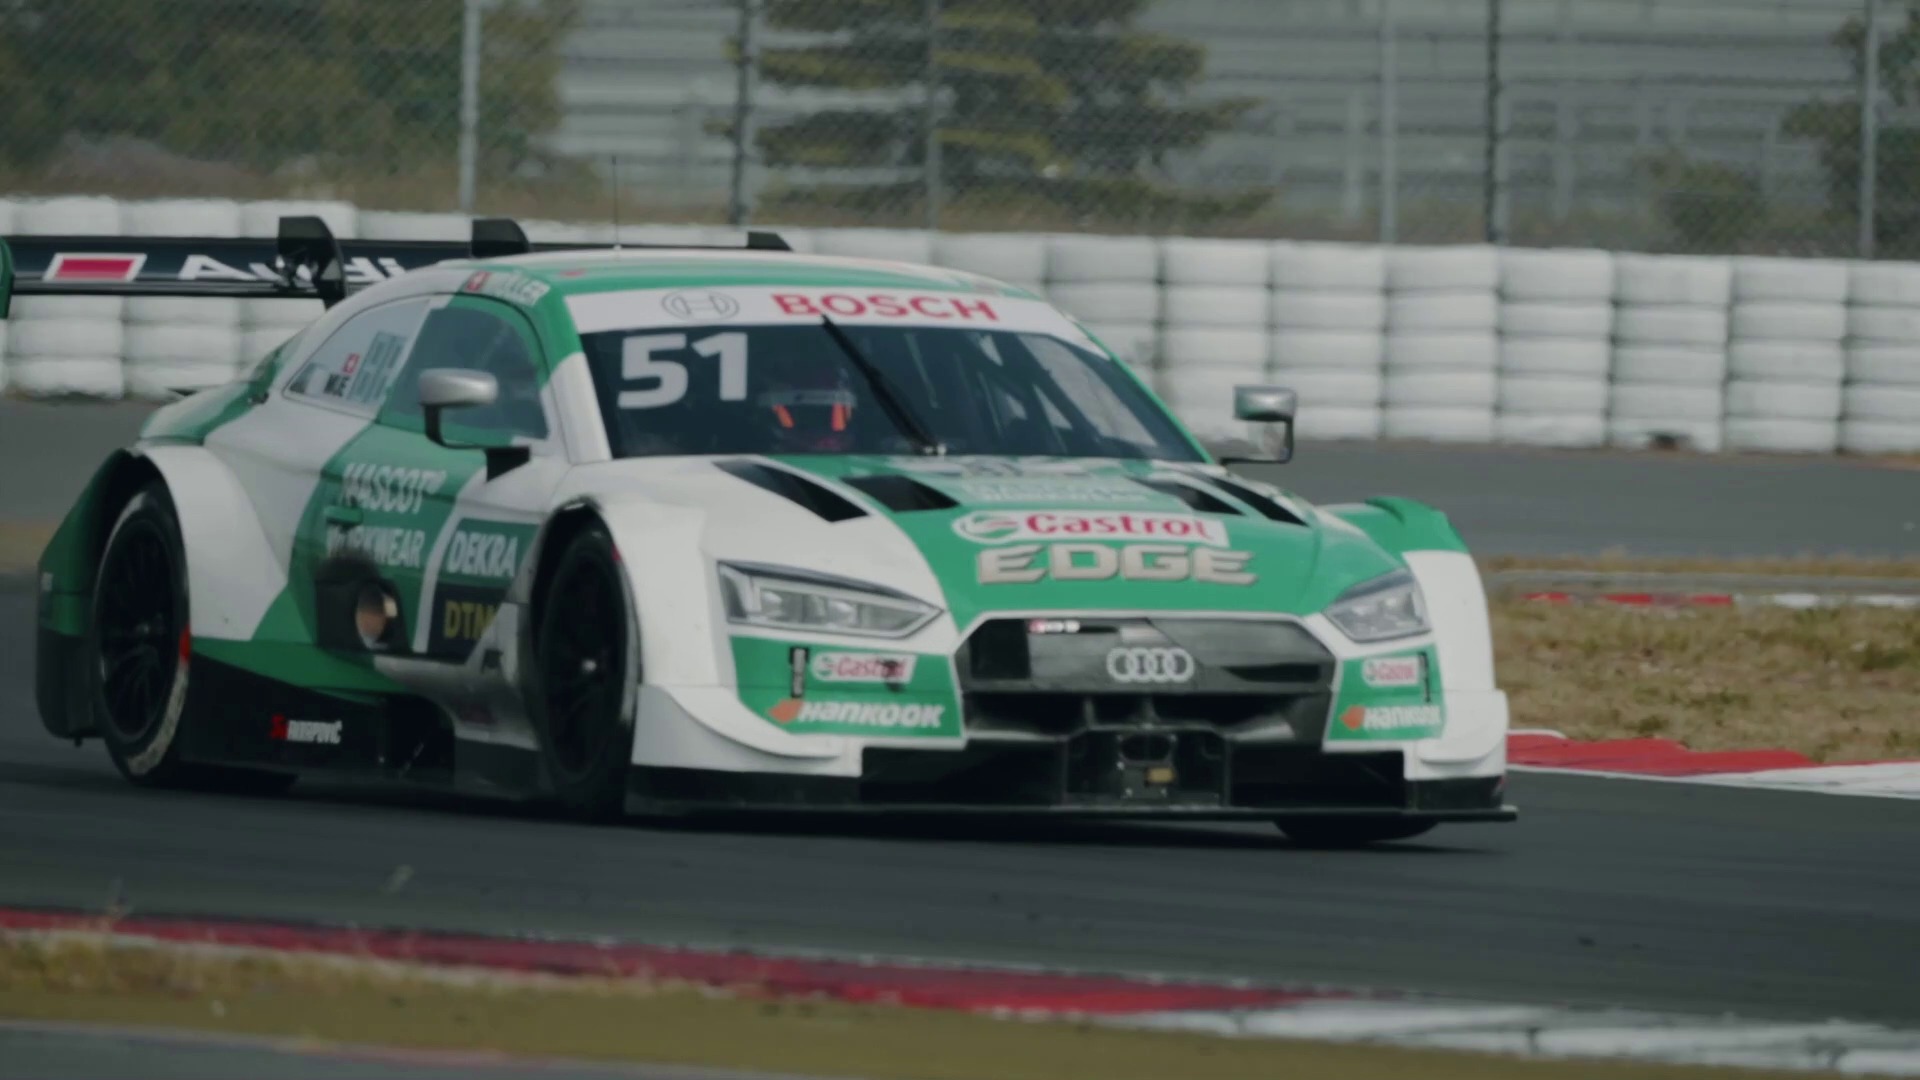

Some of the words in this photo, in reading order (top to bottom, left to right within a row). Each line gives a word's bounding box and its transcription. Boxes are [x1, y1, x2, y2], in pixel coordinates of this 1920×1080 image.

[772, 293, 999, 321] BOSCH
[616, 331, 748, 410] 51
[1026, 512, 1216, 540] Castrol
[446, 530, 519, 577] DEKRA
[977, 543, 1260, 586] EDGE
